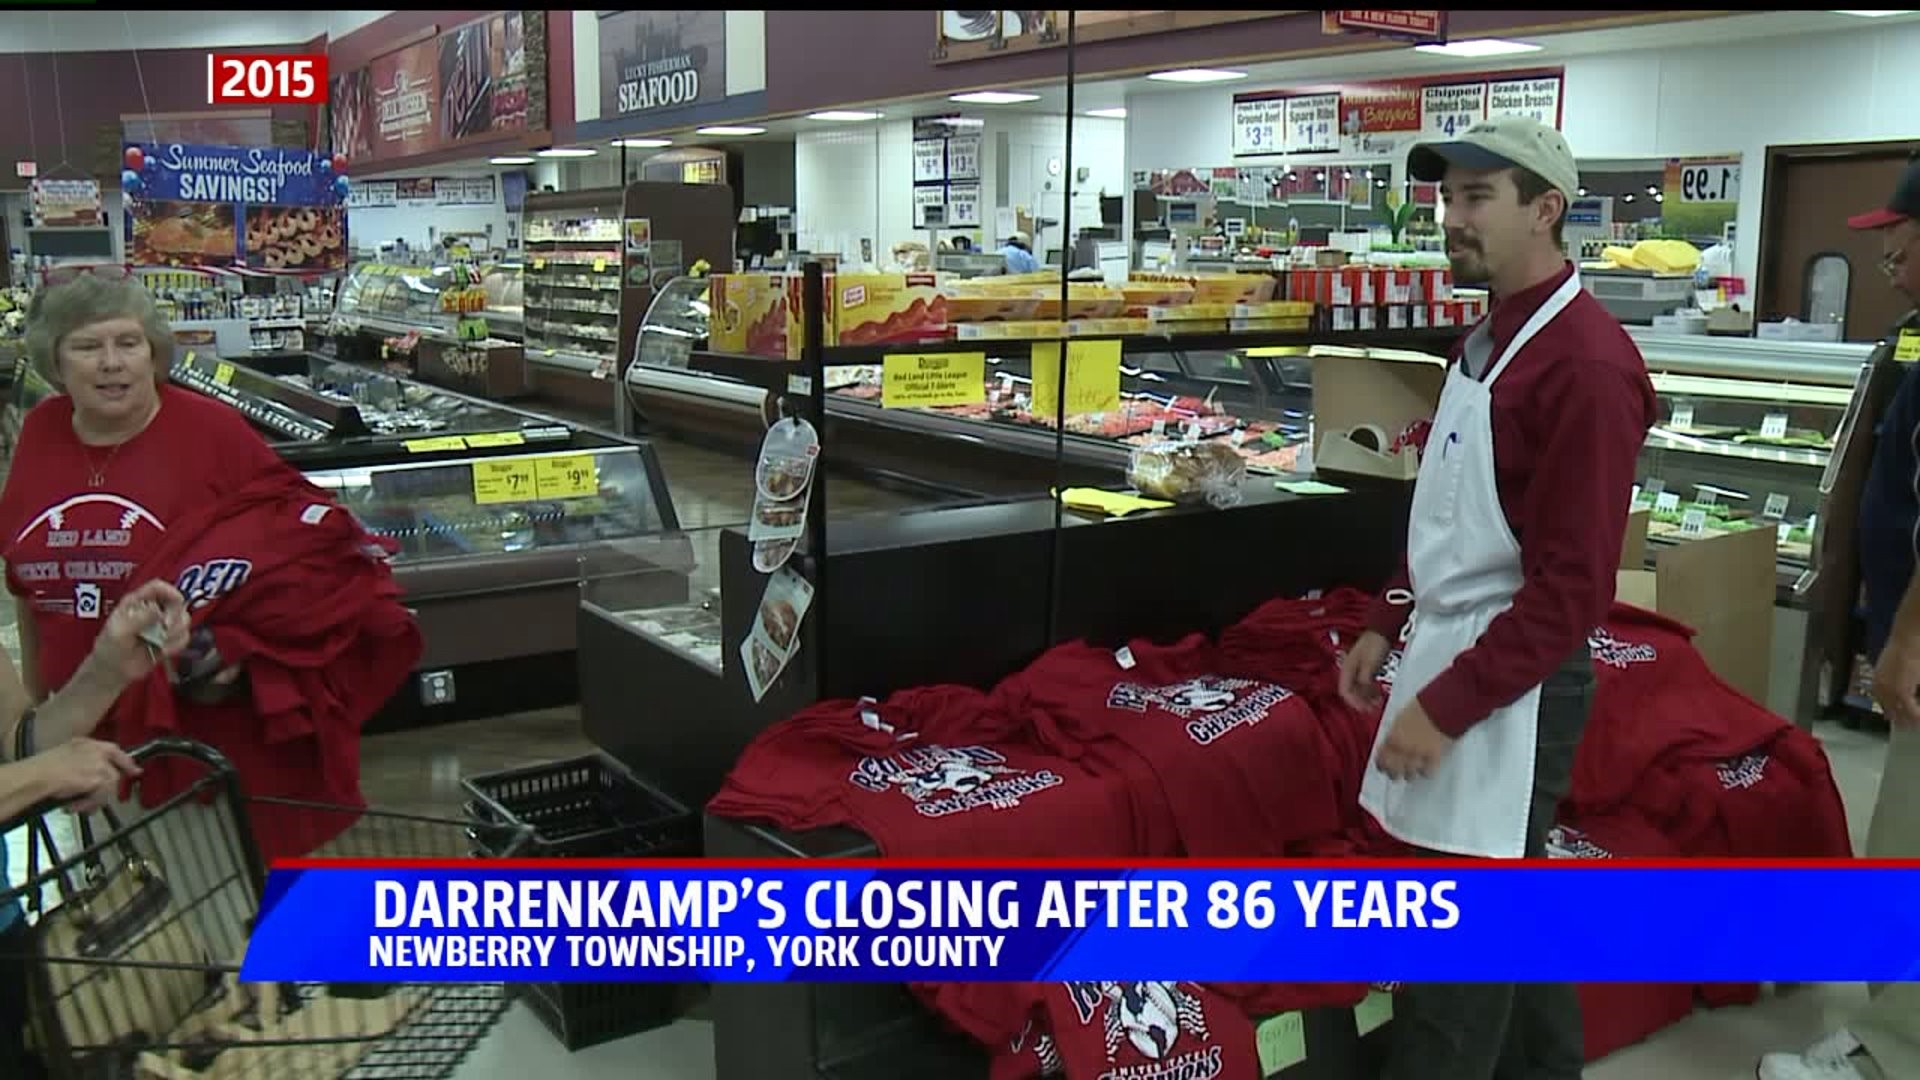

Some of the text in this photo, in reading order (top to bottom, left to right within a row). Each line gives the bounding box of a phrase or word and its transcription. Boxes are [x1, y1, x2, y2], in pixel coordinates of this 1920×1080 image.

[619, 69, 698, 112] SEAFOOD
[1426, 86, 1481, 98] Chipped
[1493, 82, 1555, 93] Grade A Split
[1492, 94, 1553, 109] Chicken Breasts
[1237, 112, 1263, 124] Ground
[1290, 107, 1335, 124] Spare Ribs
[162, 144, 313, 188] Summer Seafood
[179, 173, 277, 203] SAVINGS!
